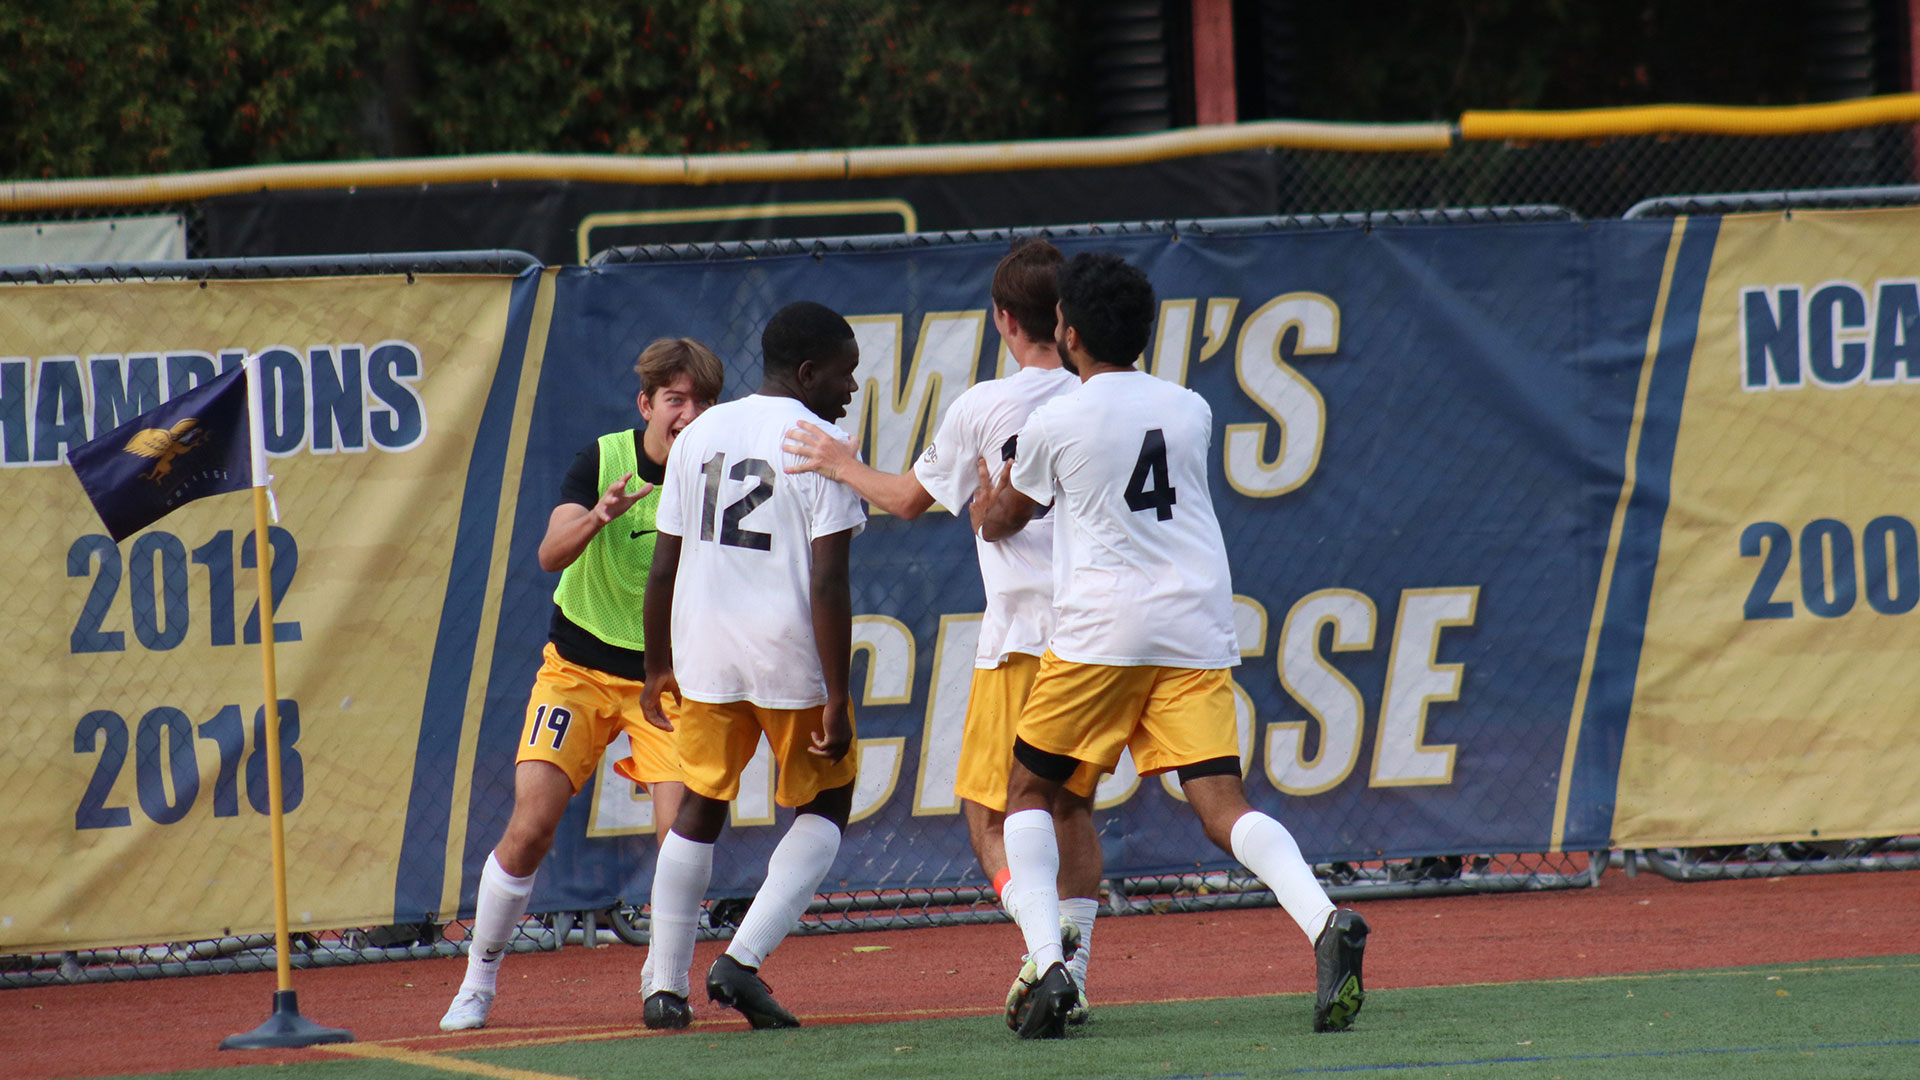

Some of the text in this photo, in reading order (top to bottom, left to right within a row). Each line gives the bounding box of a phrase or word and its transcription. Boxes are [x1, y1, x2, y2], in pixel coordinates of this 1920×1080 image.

[1738, 277, 1920, 393] NCA
[0, 340, 428, 468] HAMONS
[840, 291, 1342, 517] M'S
[700, 451, 776, 552] 12
[1123, 429, 1176, 522] 4
[67, 526, 302, 654] 2012
[1739, 515, 1920, 621] 200
[73, 699, 304, 831] 2018
[528, 704, 573, 751] 19
